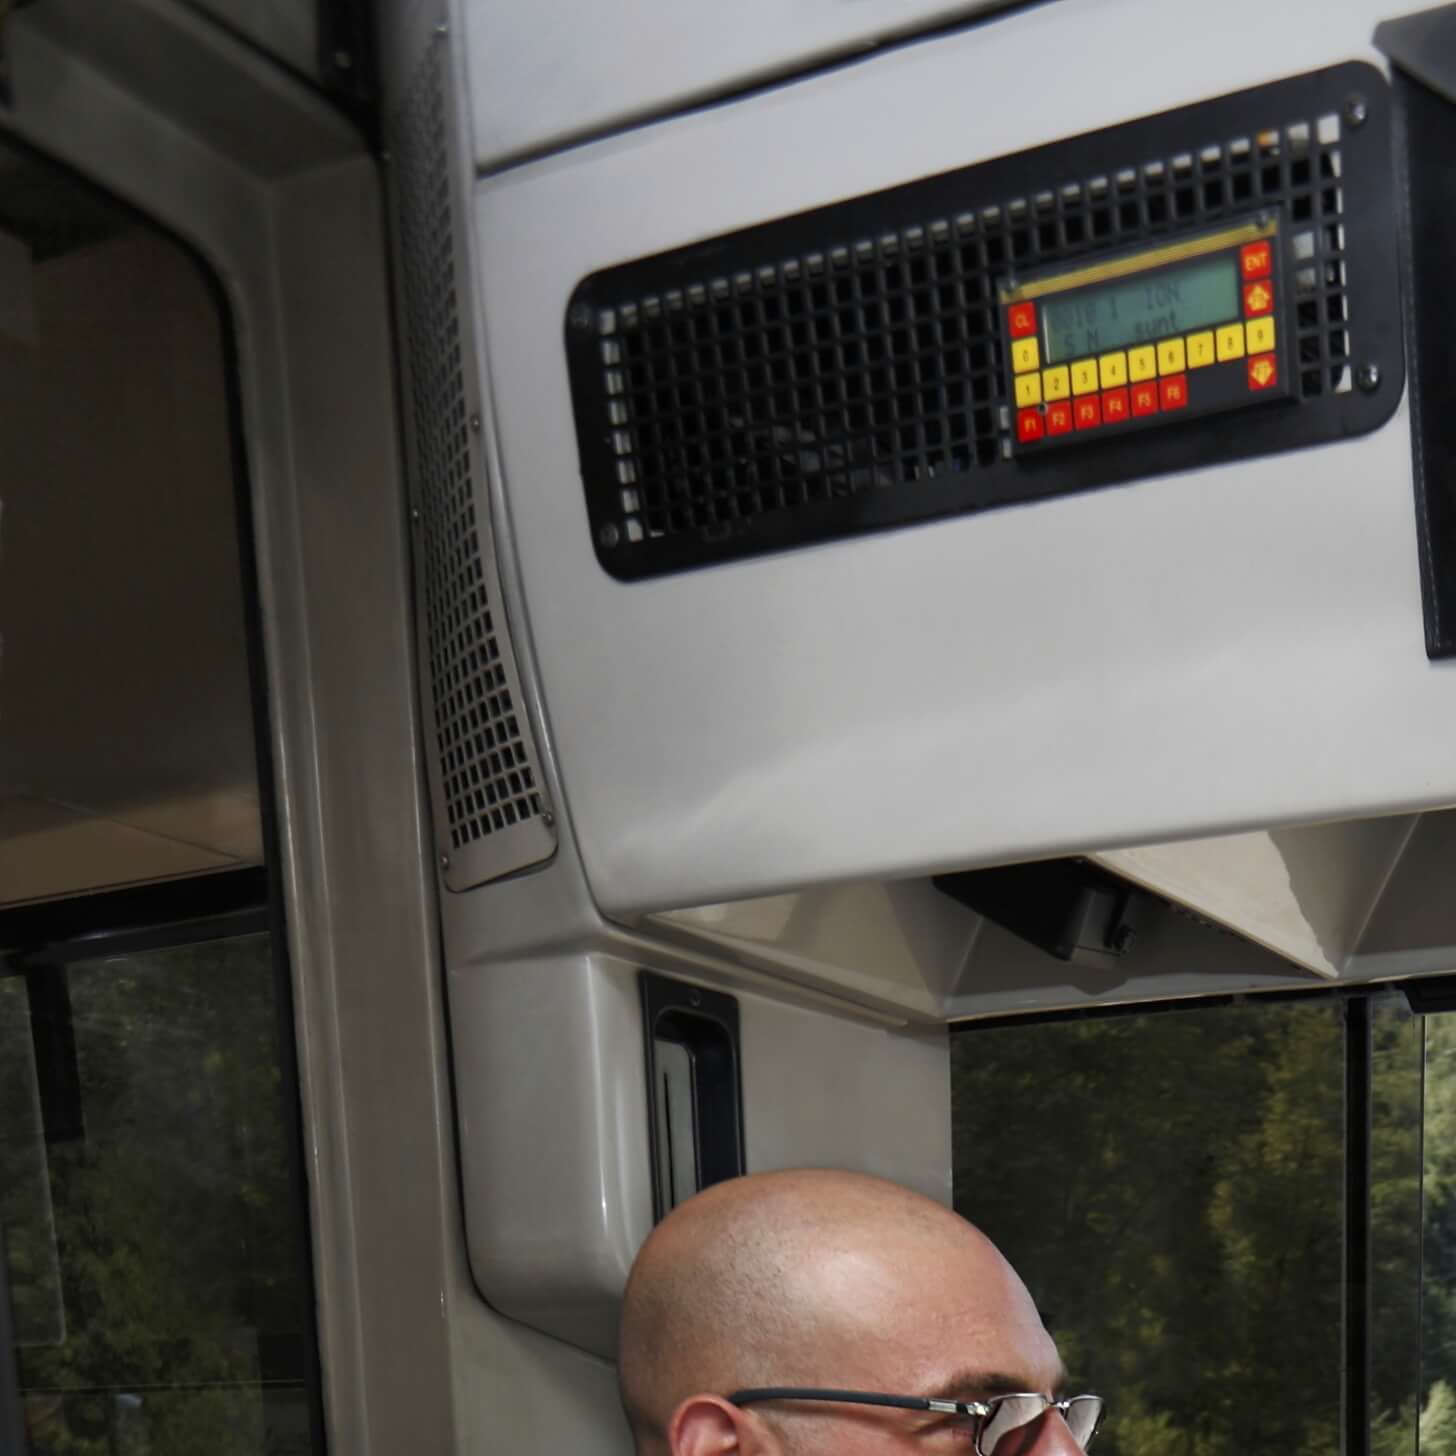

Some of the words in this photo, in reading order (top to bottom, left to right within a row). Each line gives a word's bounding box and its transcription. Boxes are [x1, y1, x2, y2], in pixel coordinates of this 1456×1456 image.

[1245, 251, 1266, 273] ENT
[1024, 419, 1037, 432] F1
[1052, 412, 1065, 426] F2
[1081, 406, 1094, 420] F3
[1109, 400, 1122, 413] F4
[1138, 394, 1151, 408] F5
[1167, 386, 1180, 400] F6
